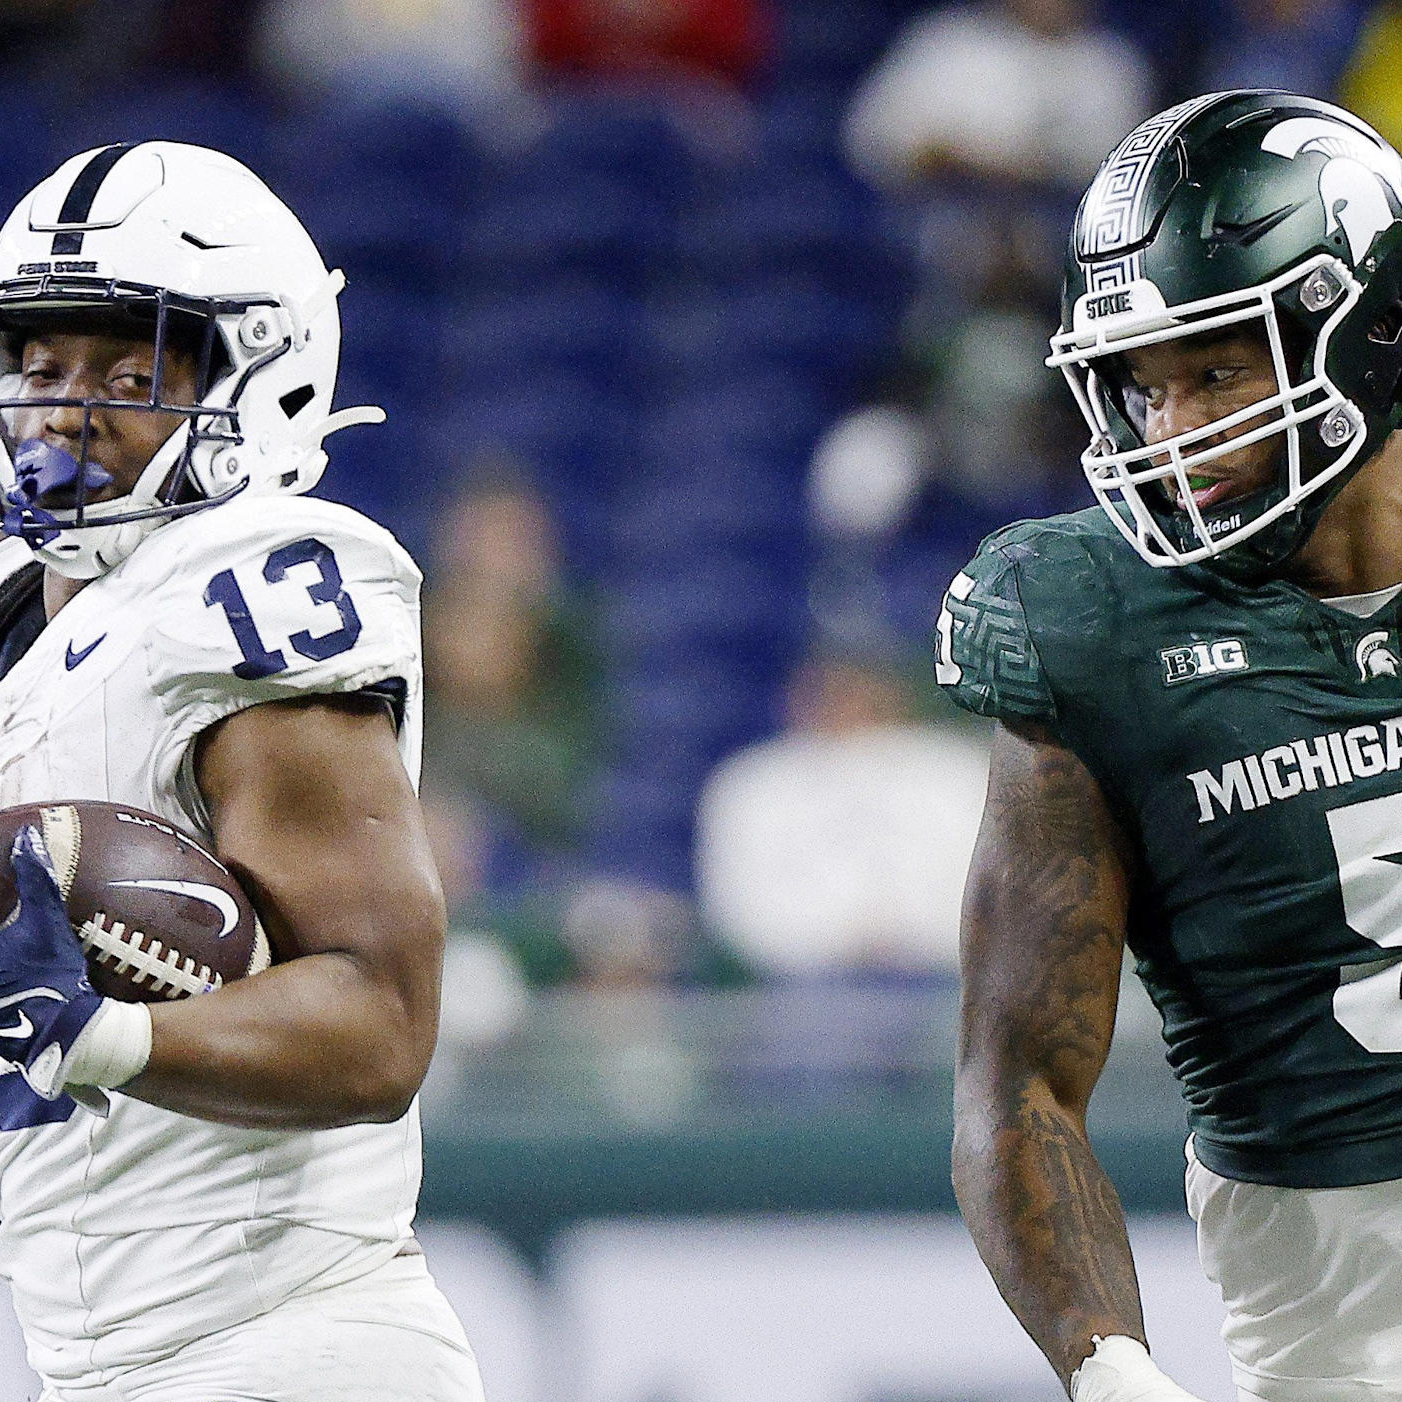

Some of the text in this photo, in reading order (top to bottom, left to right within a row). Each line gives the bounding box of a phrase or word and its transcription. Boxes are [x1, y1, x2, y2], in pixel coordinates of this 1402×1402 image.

[1086, 290, 1133, 320] STATE
[1192, 513, 1241, 540] Rddell
[203, 537, 363, 681] 13
